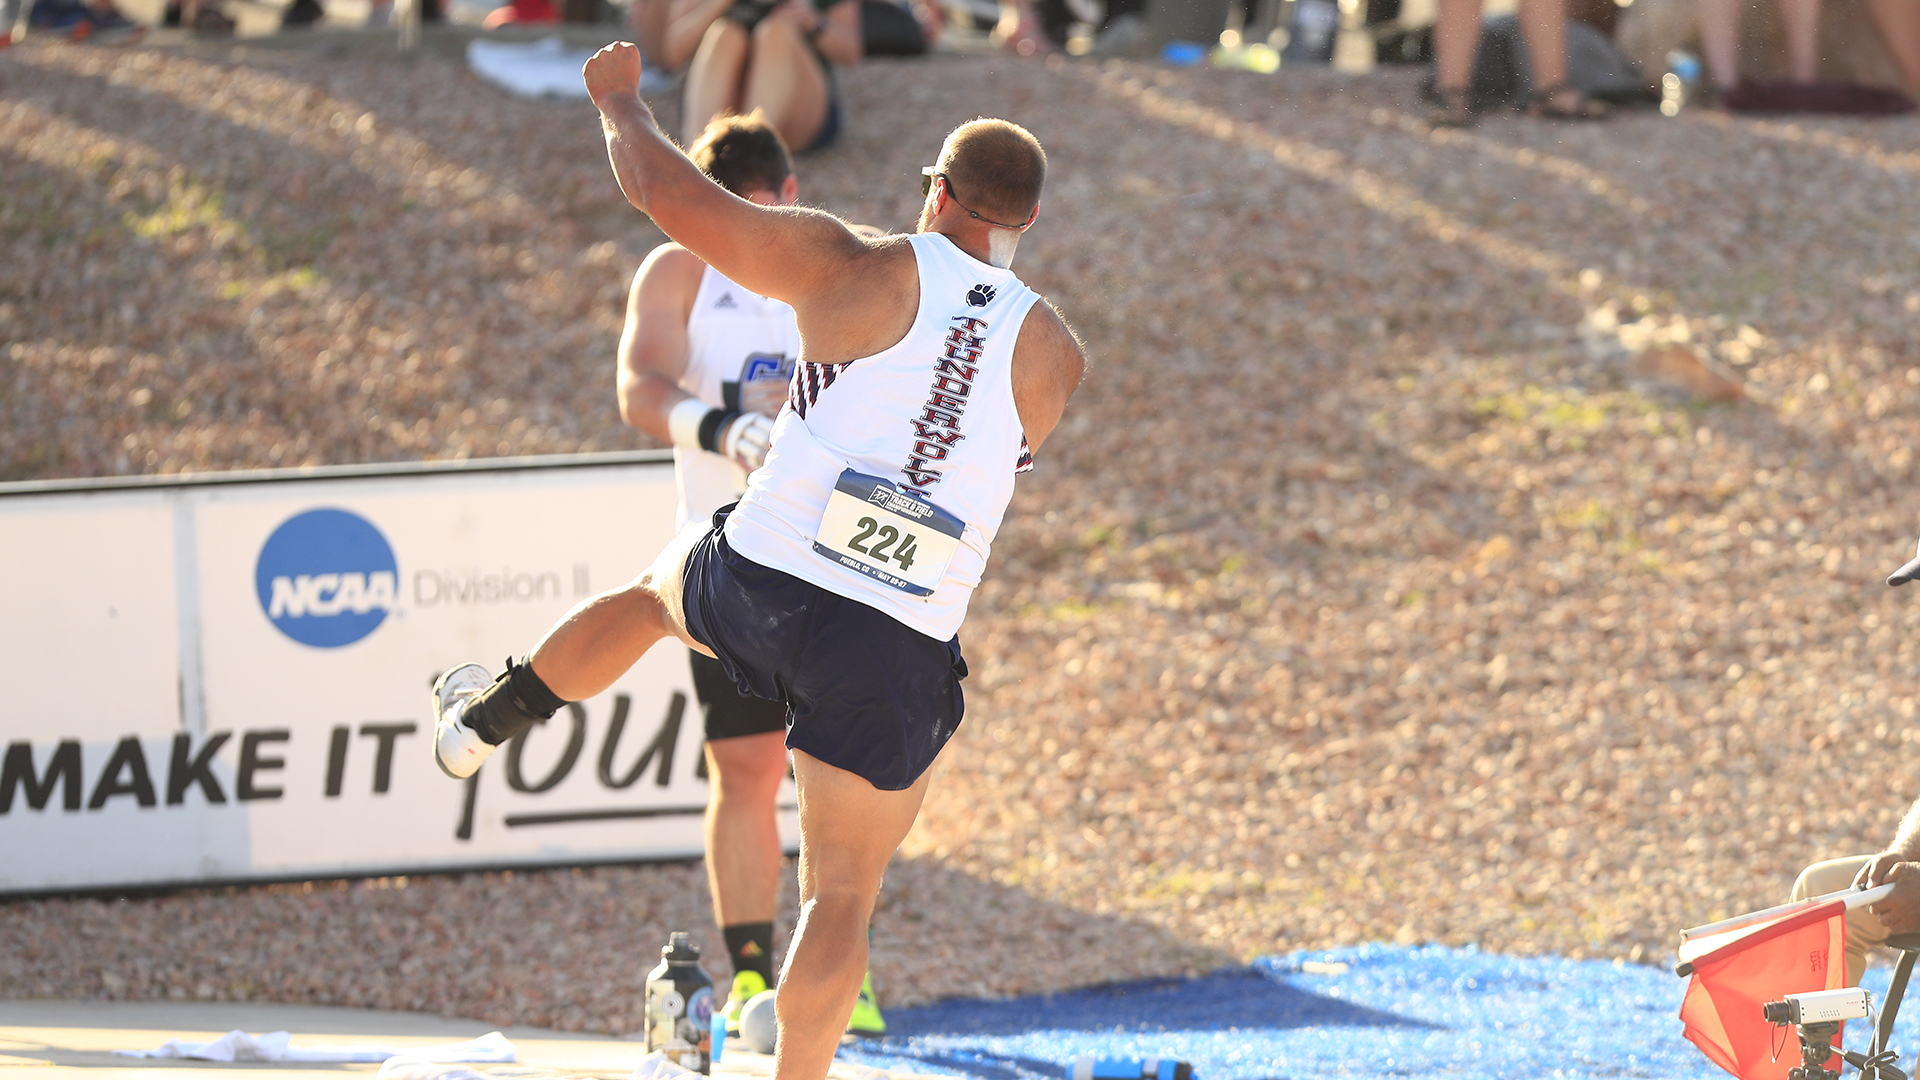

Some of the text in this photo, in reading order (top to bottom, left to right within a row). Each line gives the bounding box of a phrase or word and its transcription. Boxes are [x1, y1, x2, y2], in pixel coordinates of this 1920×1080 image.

[889, 495, 912, 509] TRACK
[915, 506, 934, 518] FIELD
[847, 516, 918, 572] 224
[268, 570, 397, 619] NCAA
[413, 563, 591, 609] Division II
[878, 571, 892, 581] MAY
[0, 728, 291, 816] MAKE
[323, 720, 417, 799] IT
